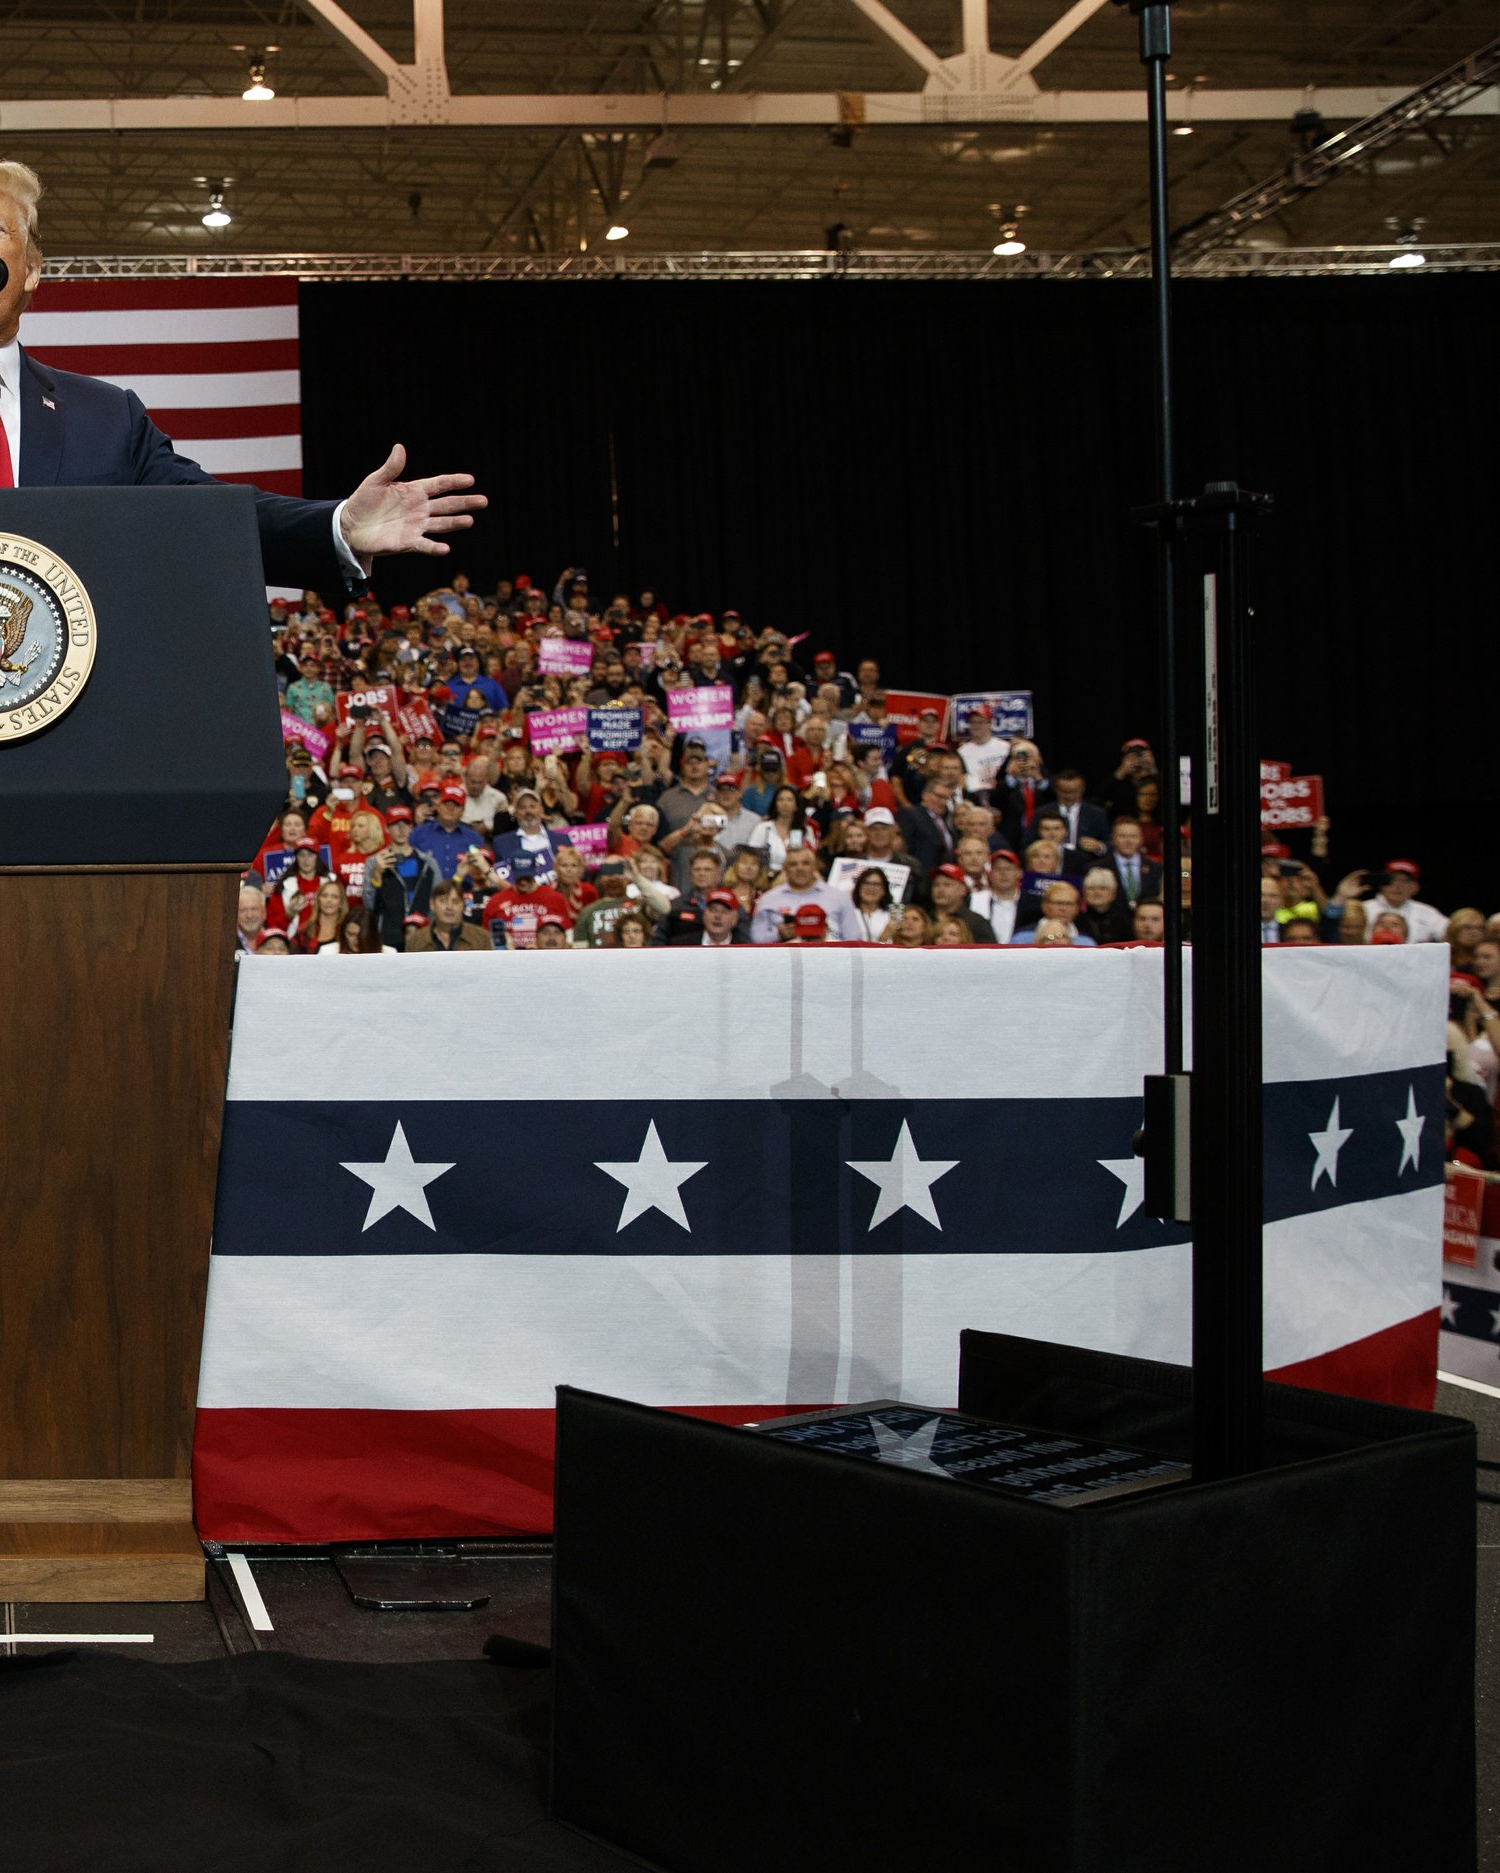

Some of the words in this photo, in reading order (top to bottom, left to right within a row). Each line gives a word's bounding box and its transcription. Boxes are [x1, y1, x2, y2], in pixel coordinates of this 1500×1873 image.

[13, 545, 40, 567] THE
[44, 563, 90, 648] UNITED
[540, 661, 590, 674] TRUMP
[8, 665, 81, 732] STATES
[344, 689, 388, 709] JOBS
[667, 689, 731, 704] WOMEN
[530, 712, 586, 728] WOMEN
[590, 712, 638, 720] PROMISES
[669, 712, 732, 728] TRUMP
[281, 712, 329, 749] WOMEN
[600, 721, 630, 729] MADE
[590, 730, 638, 738] PROMISES
[567, 828, 608, 843] OMEN
